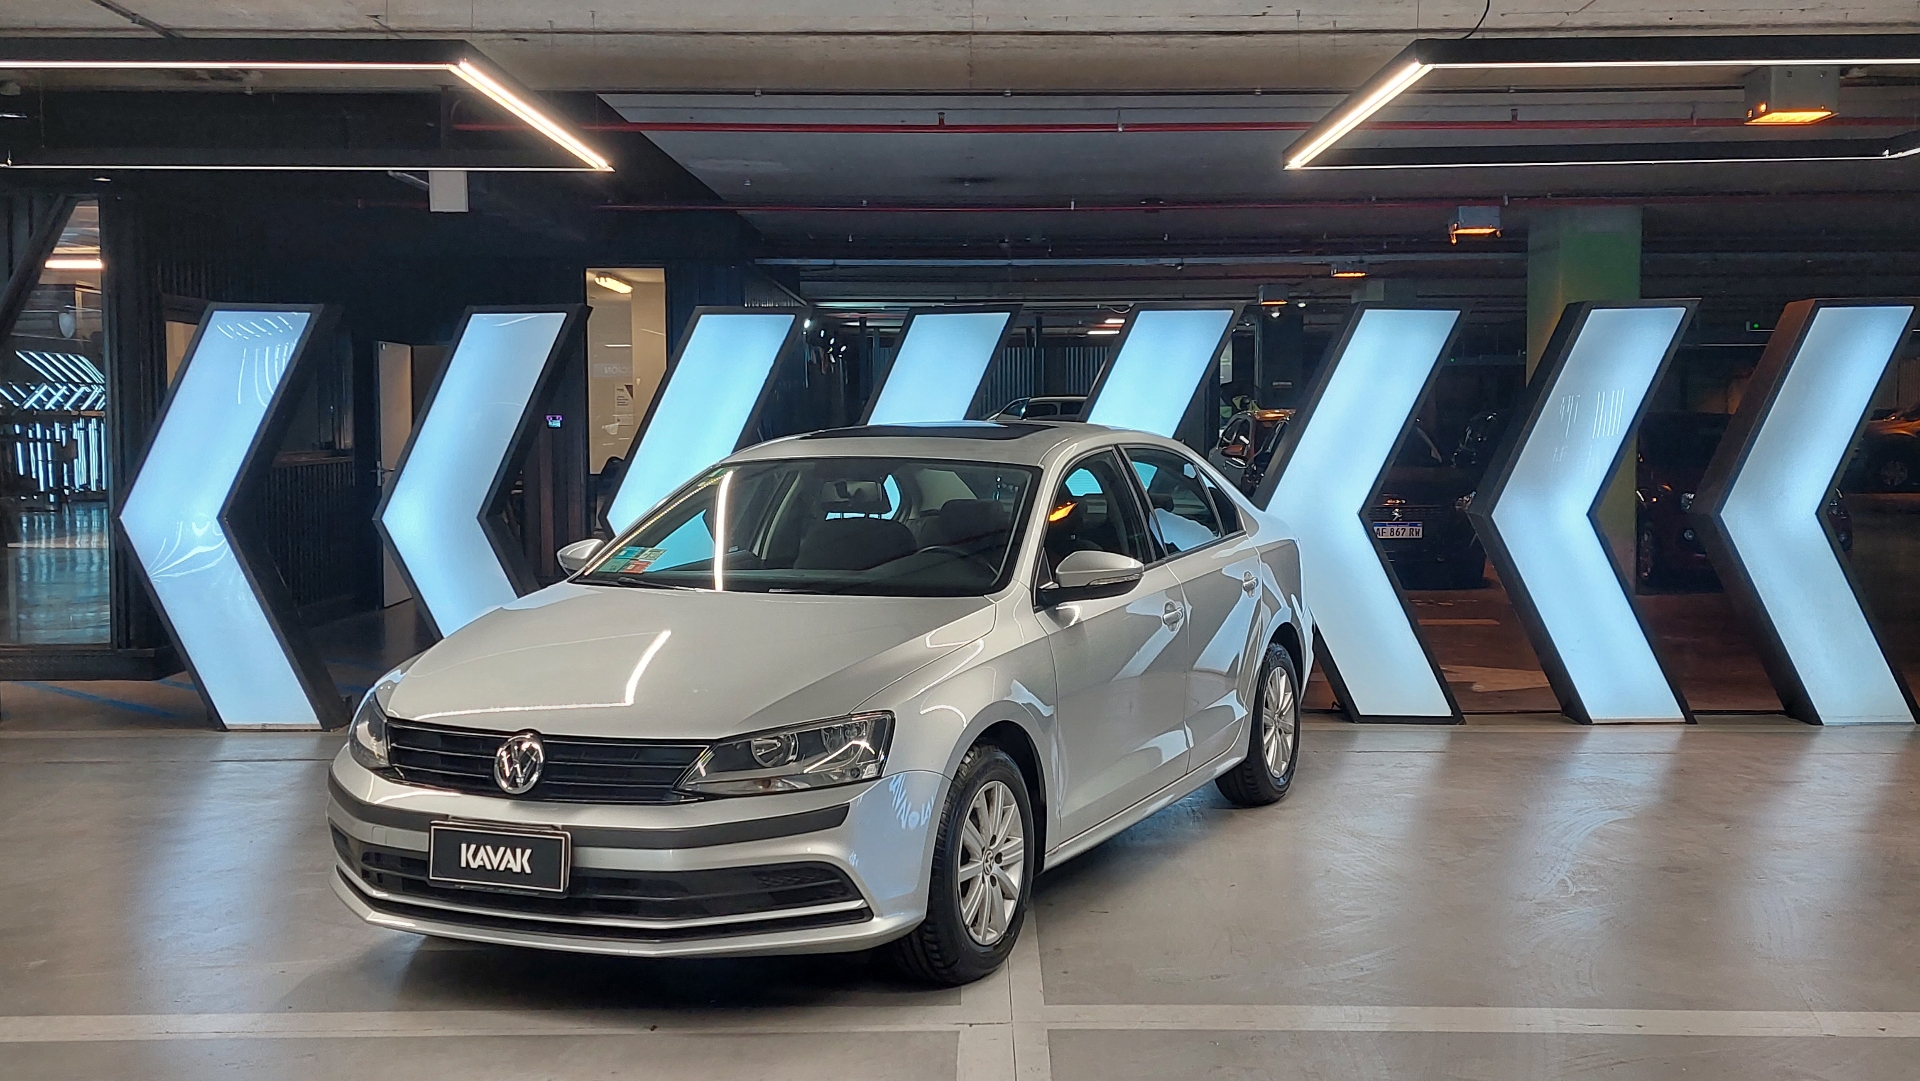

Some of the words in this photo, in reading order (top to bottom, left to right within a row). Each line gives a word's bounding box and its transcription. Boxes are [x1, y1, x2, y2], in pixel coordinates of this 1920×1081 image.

[1376, 527, 1387, 536] AF
[1389, 527, 1406, 536] 867
[1409, 527, 1421, 536] RW
[460, 843, 532, 874] KAVAK
